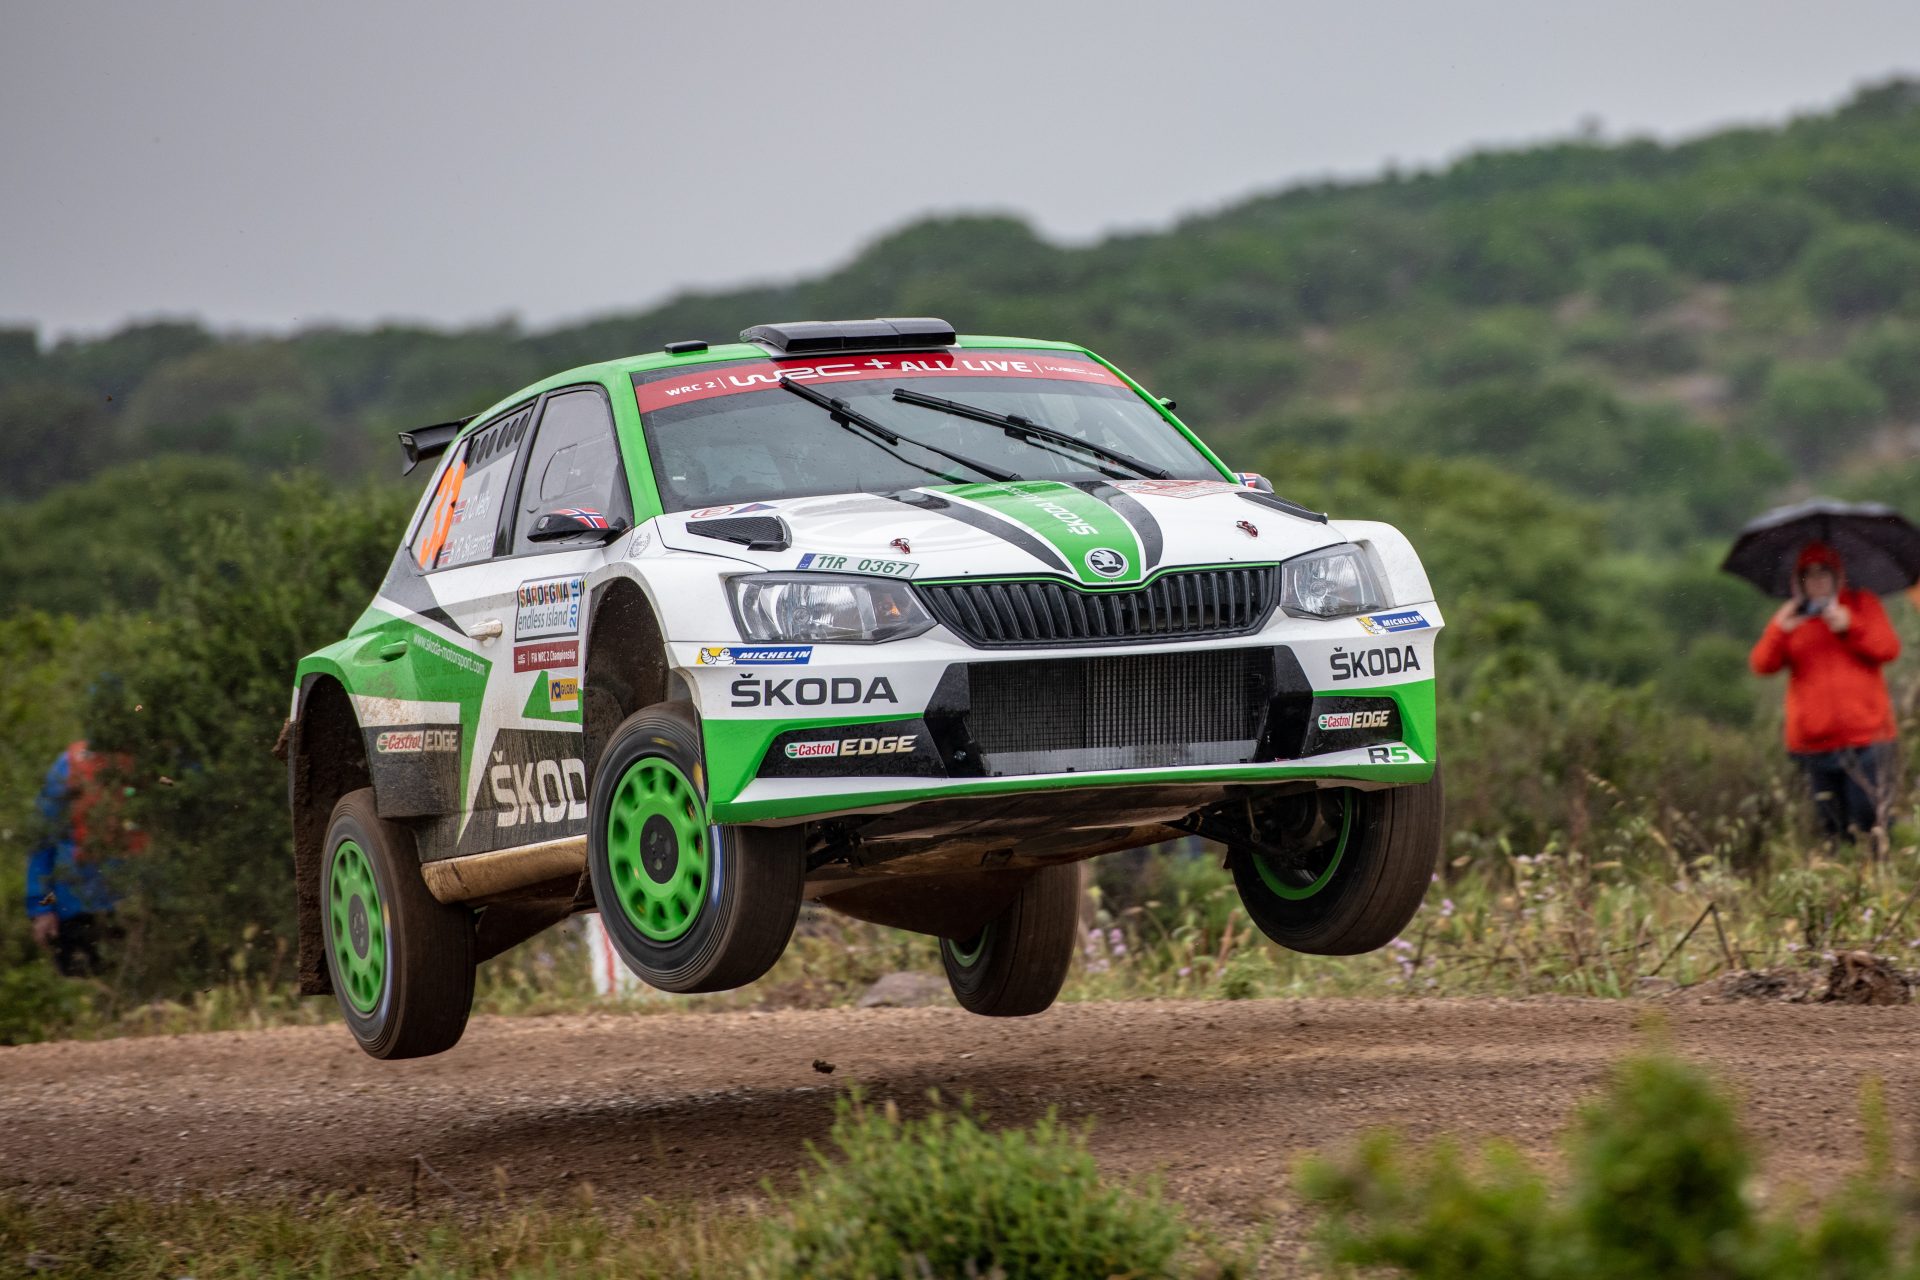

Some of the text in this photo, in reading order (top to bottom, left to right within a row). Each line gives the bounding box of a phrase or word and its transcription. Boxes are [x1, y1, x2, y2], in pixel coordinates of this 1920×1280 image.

[665, 384, 702, 396] WRC
[705, 381, 717, 389] 2
[901, 360, 958, 372] ALL
[961, 360, 1033, 373] LIVE
[818, 555, 909, 575] 11R 0367
[519, 581, 570, 608] SARDEGNA
[517, 604, 569, 631] endless island
[1382, 615, 1424, 627] MICHELIN
[738, 650, 811, 659] MICHELIN
[1330, 645, 1421, 681] ŠKODA
[731, 673, 899, 707] ŠKODA
[1327, 710, 1391, 728] Castrol EDGE
[388, 730, 458, 752] Castrol EDGE
[798, 734, 919, 756] Castrol EDGE
[1367, 746, 1410, 764] R5
[491, 750, 588, 827] ŠKOD
